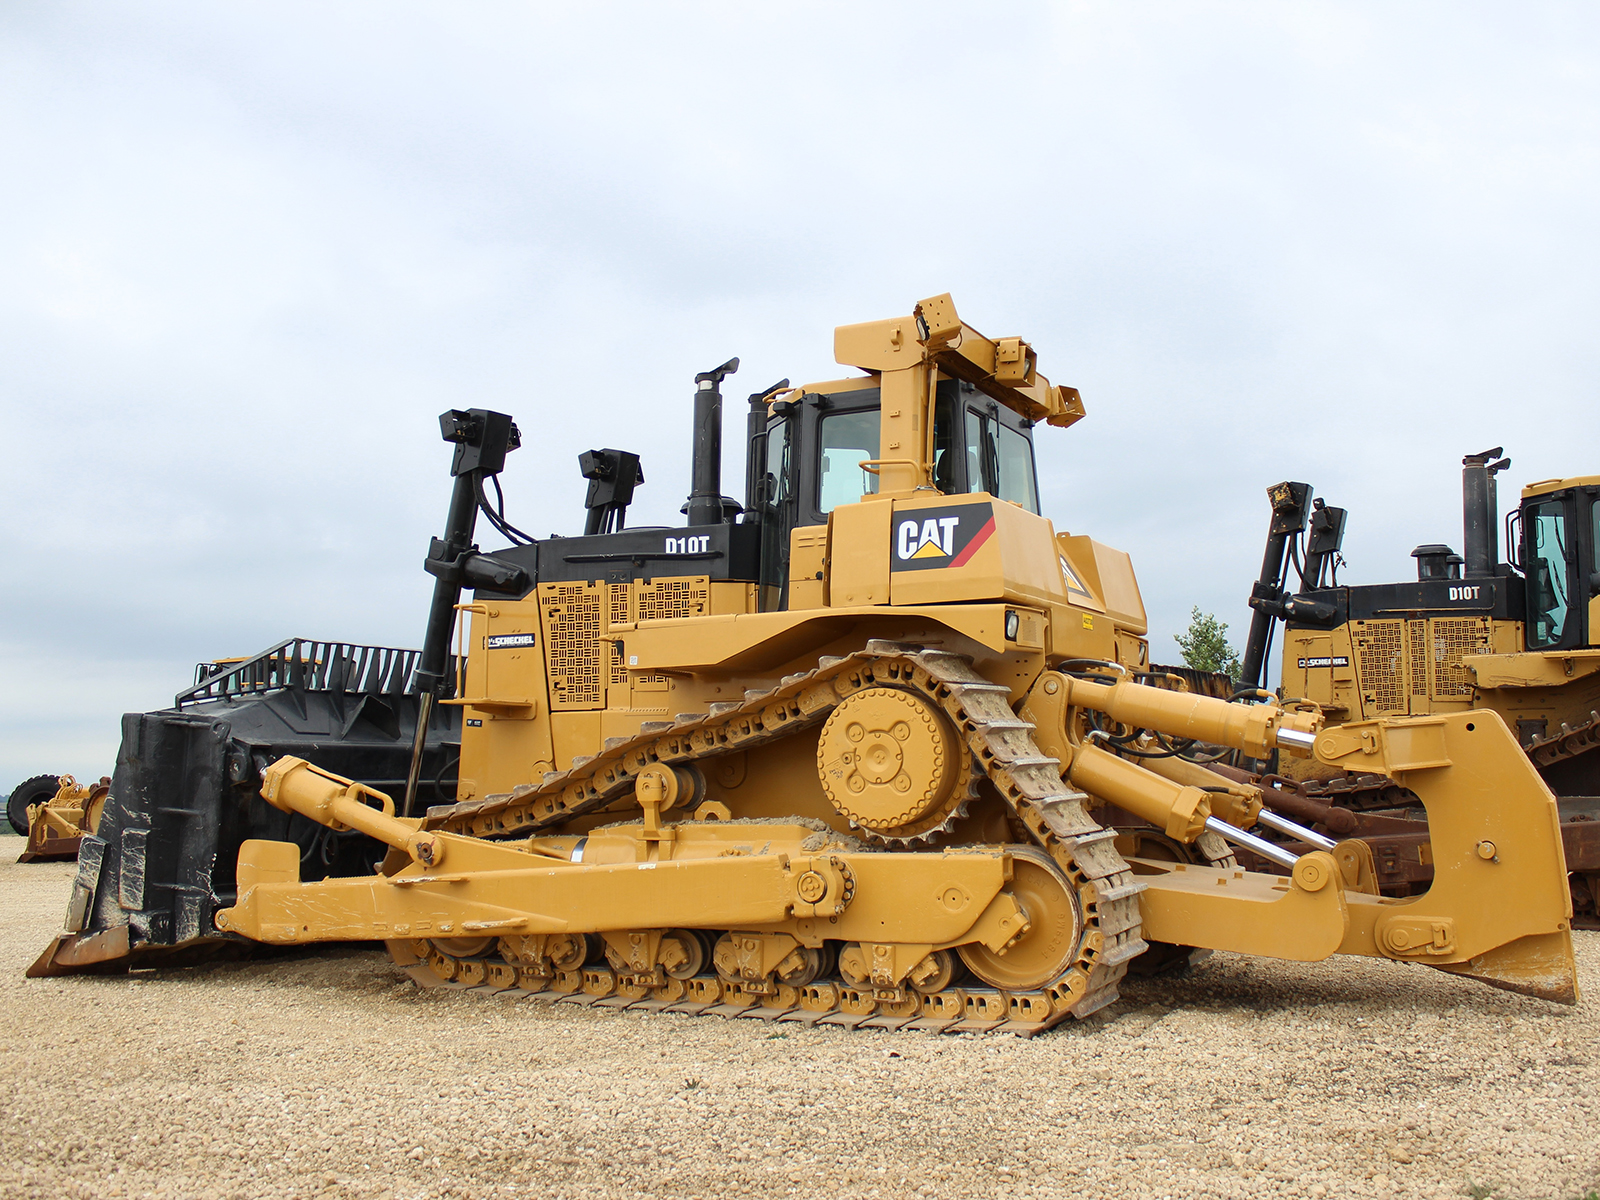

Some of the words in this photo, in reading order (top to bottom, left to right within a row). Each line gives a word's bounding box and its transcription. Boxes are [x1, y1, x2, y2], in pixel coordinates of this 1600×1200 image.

[665, 535, 710, 554] D10T
[897, 516, 959, 560] CAT
[1449, 586, 1480, 601] D10T
[494, 635, 535, 646] SCHECKEL
